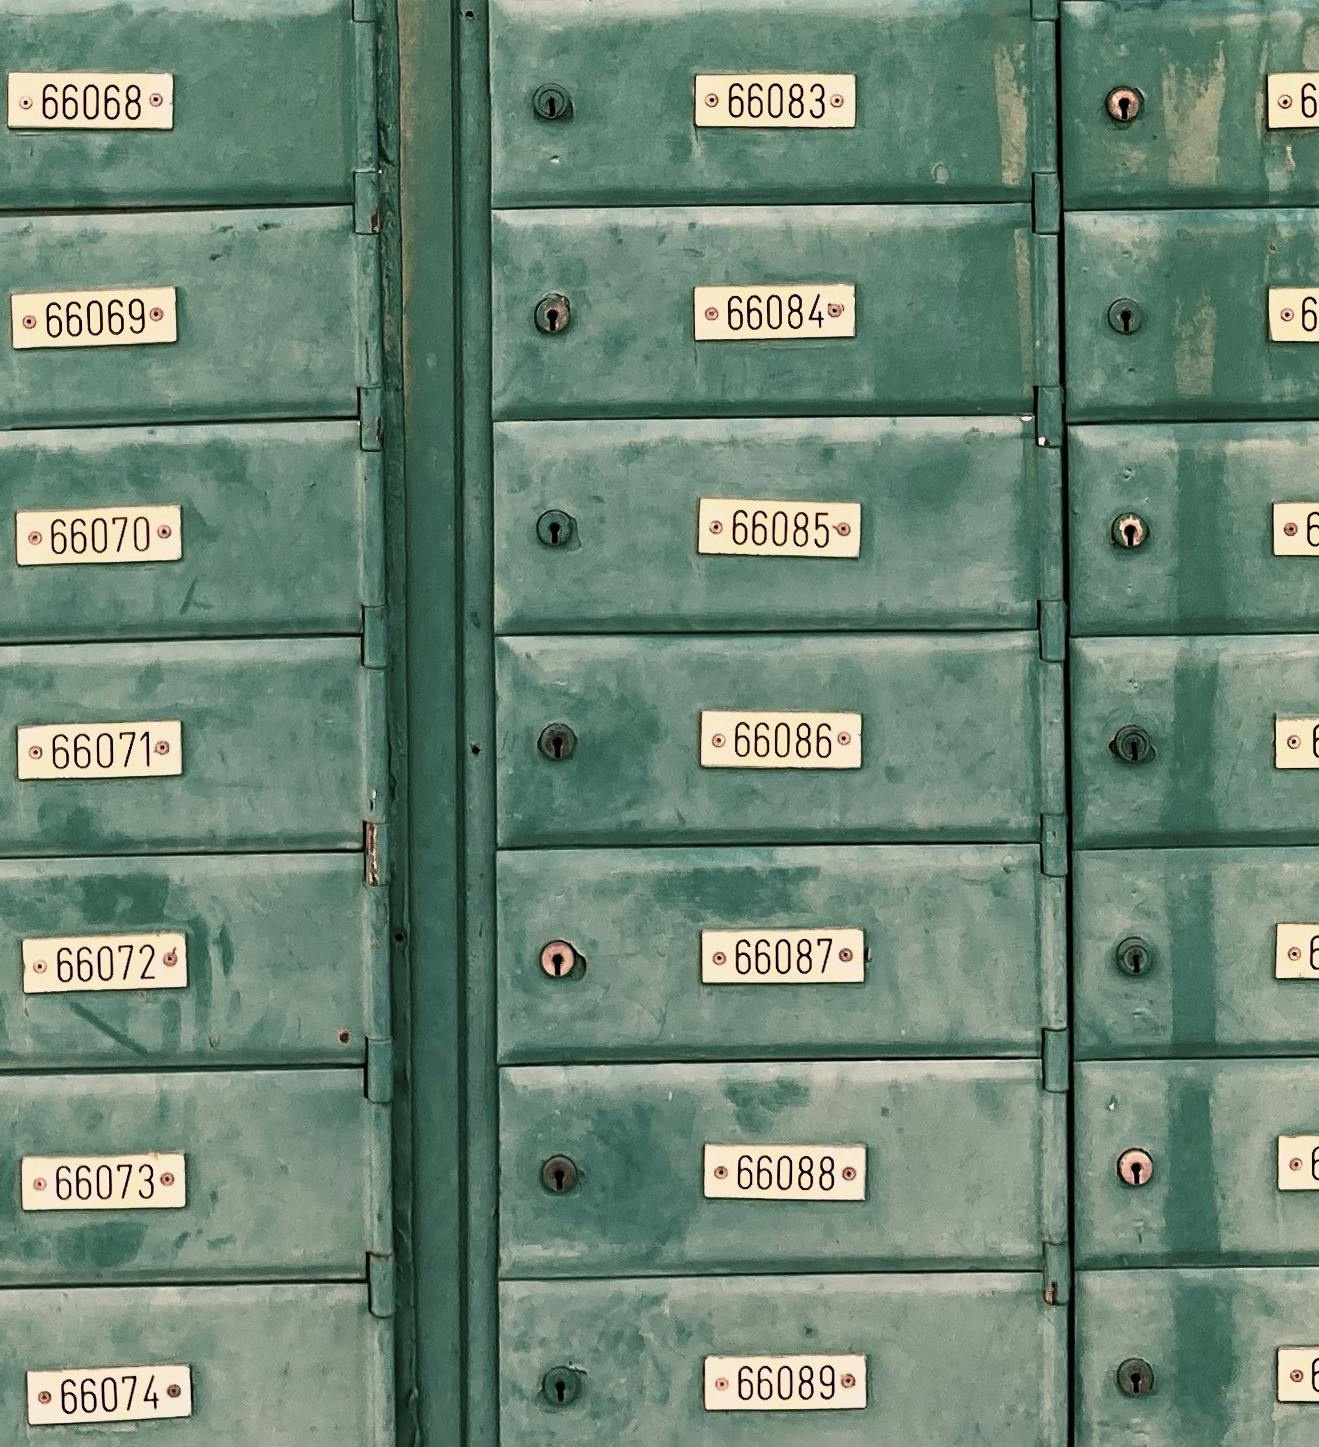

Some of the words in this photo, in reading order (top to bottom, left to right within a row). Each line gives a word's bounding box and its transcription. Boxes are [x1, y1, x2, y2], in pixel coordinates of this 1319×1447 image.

[42, 83, 142, 121] 66068
[728, 82, 826, 120] 66083
[45, 298, 146, 339] 66069
[727, 293, 825, 331] 66084
[50, 516, 151, 555] 66070
[732, 509, 830, 549] 66085
[51, 731, 150, 770] 66071
[734, 721, 832, 759] 66086
[56, 943, 156, 983] 66072
[735, 937, 833, 976] 66087
[55, 1163, 155, 1201] 66073
[737, 1154, 835, 1192] 66088
[60, 1374, 160, 1415] 66074
[737, 1364, 836, 1401] 66089
